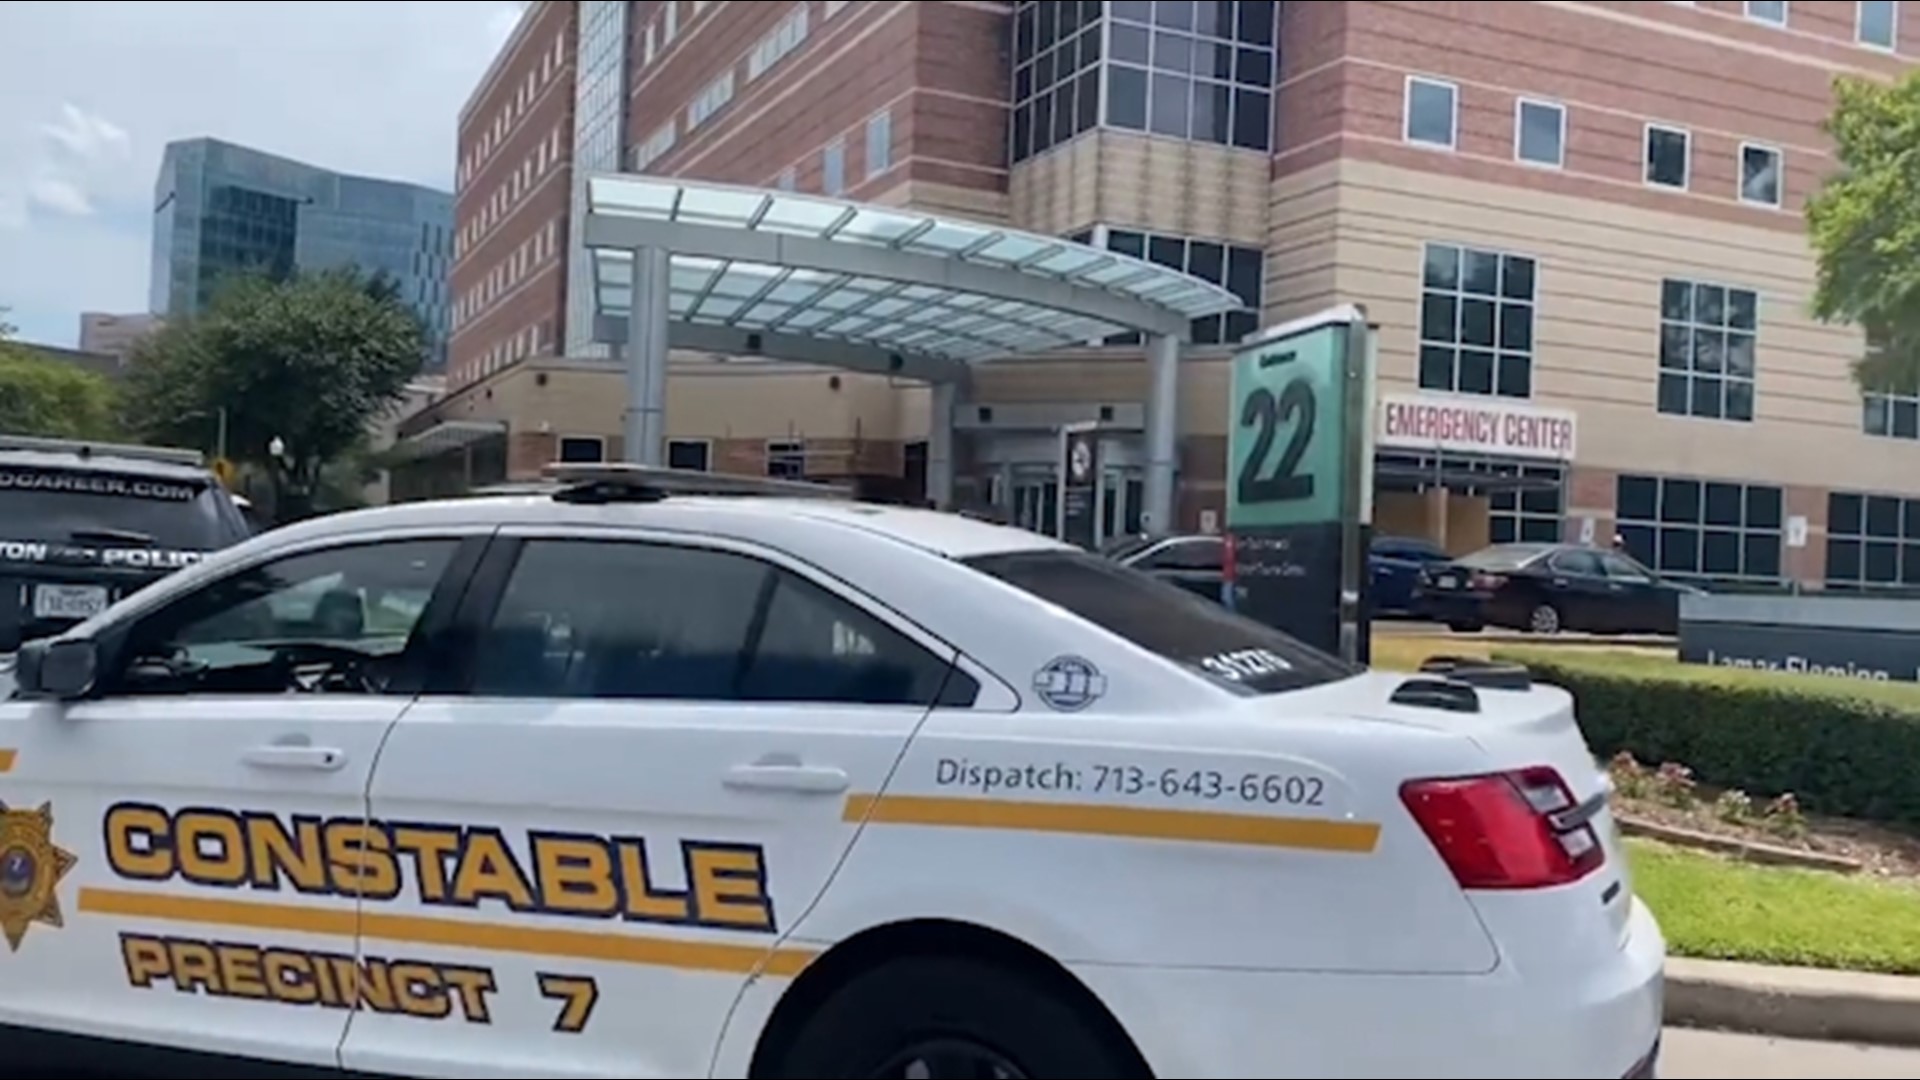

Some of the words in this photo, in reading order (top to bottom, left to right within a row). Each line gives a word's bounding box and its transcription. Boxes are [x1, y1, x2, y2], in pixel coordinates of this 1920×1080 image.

[1238, 377, 1316, 504] 22
[1386, 402, 1499, 444] EMERGENCY
[1504, 413, 1573, 450] CENTER
[102, 549, 208, 569] POLIC
[936, 758, 1083, 793] Dispatch:
[1091, 764, 1324, 807] 713-643-6602
[103, 801, 778, 934] CONSTABLE
[118, 931, 498, 1025] PRECINCT
[536, 971, 599, 1034] 7
